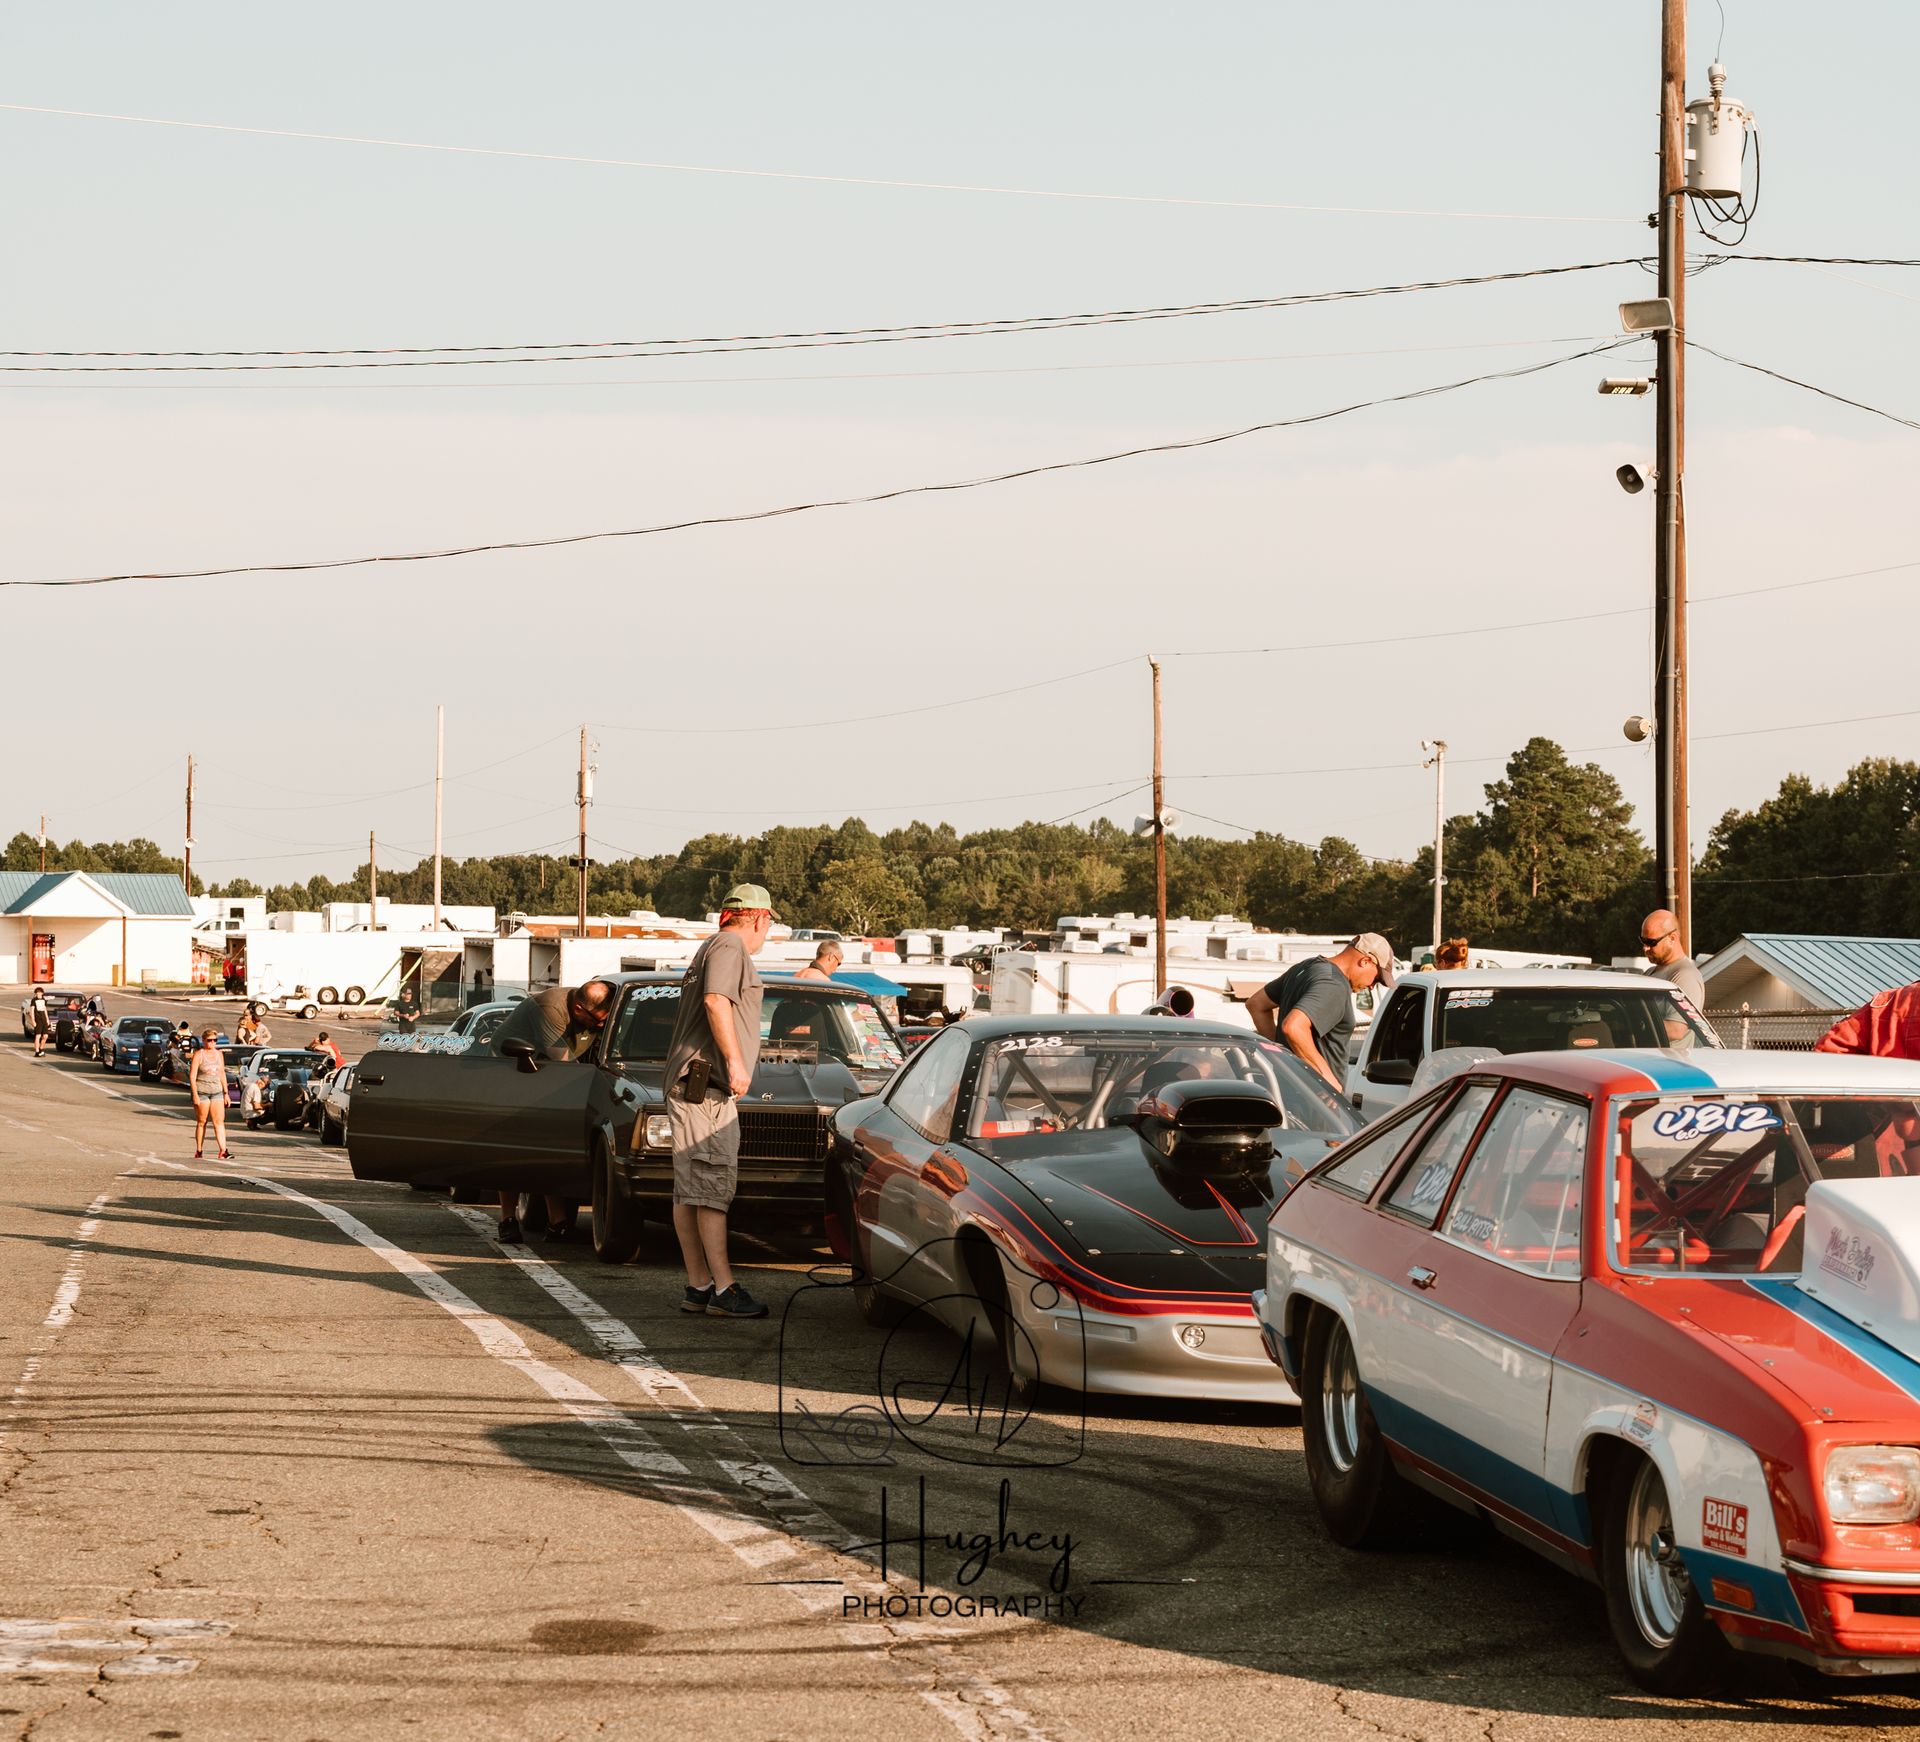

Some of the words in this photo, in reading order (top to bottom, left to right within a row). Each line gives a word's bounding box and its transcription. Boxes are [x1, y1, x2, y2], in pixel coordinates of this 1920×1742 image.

[378, 1032, 419, 1052] CODY
[1000, 1036, 1064, 1053] 2128
[1706, 1501, 1745, 1533] Bill's
